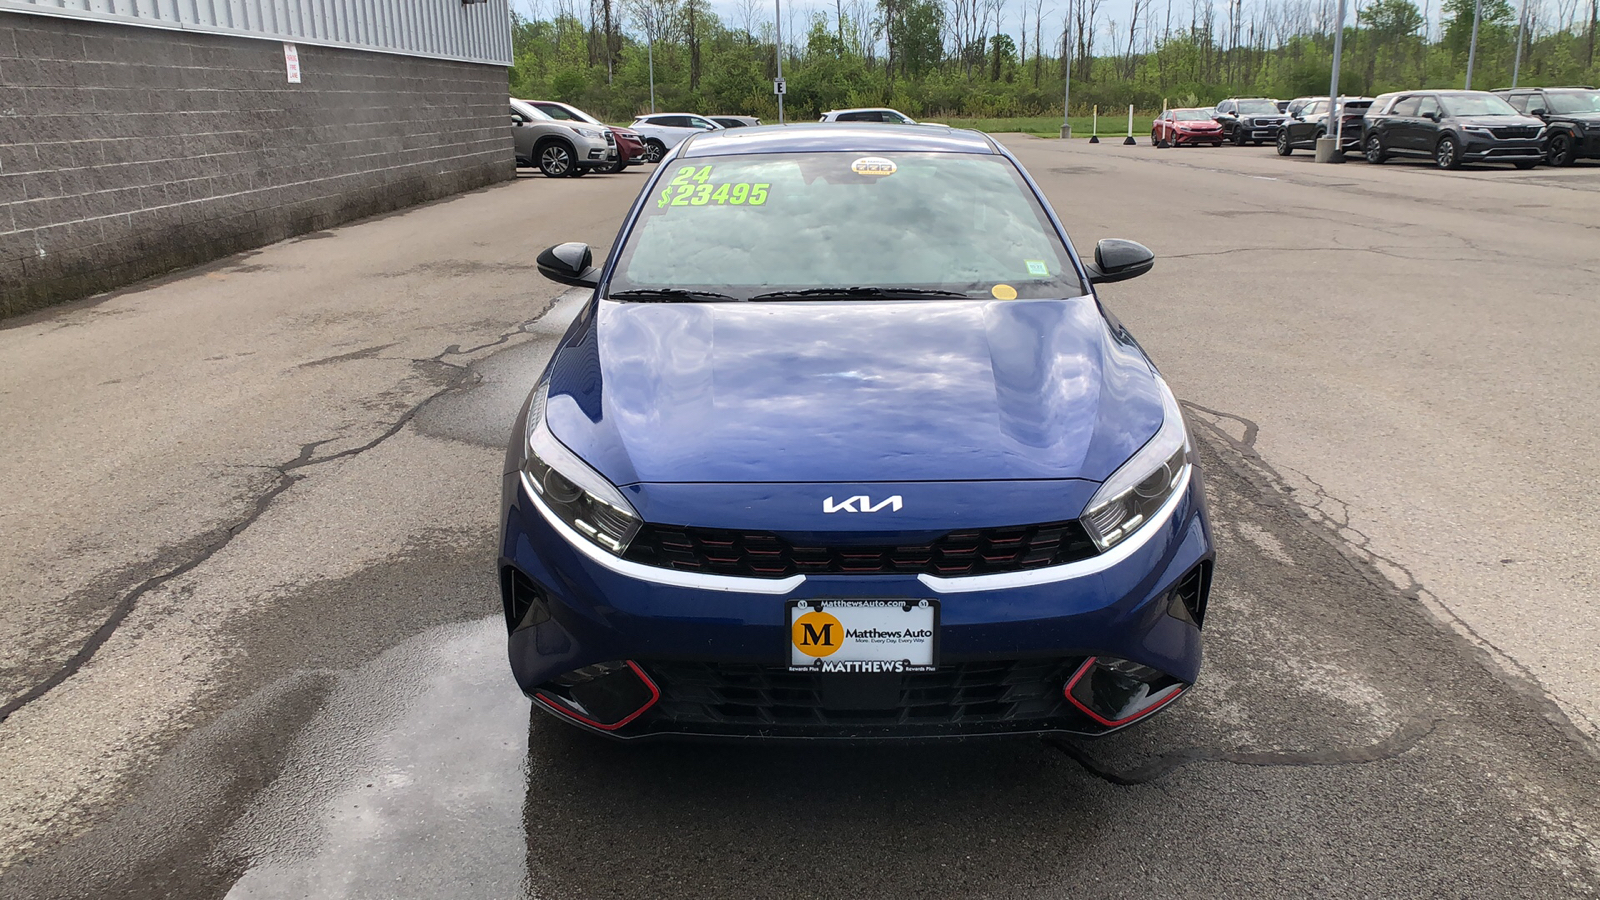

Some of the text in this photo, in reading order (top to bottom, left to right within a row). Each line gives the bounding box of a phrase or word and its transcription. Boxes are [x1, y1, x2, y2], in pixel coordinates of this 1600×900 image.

[777, 82, 783, 93] E
[671, 165, 713, 186] 24
[657, 183, 770, 209] $23495
[823, 495, 903, 513] KIA
[820, 600, 906, 608] MatthewsAuto.com
[800, 623, 834, 646] M
[845, 628, 933, 639] Matthews Auto
[821, 661, 904, 673] MATTHEWS
